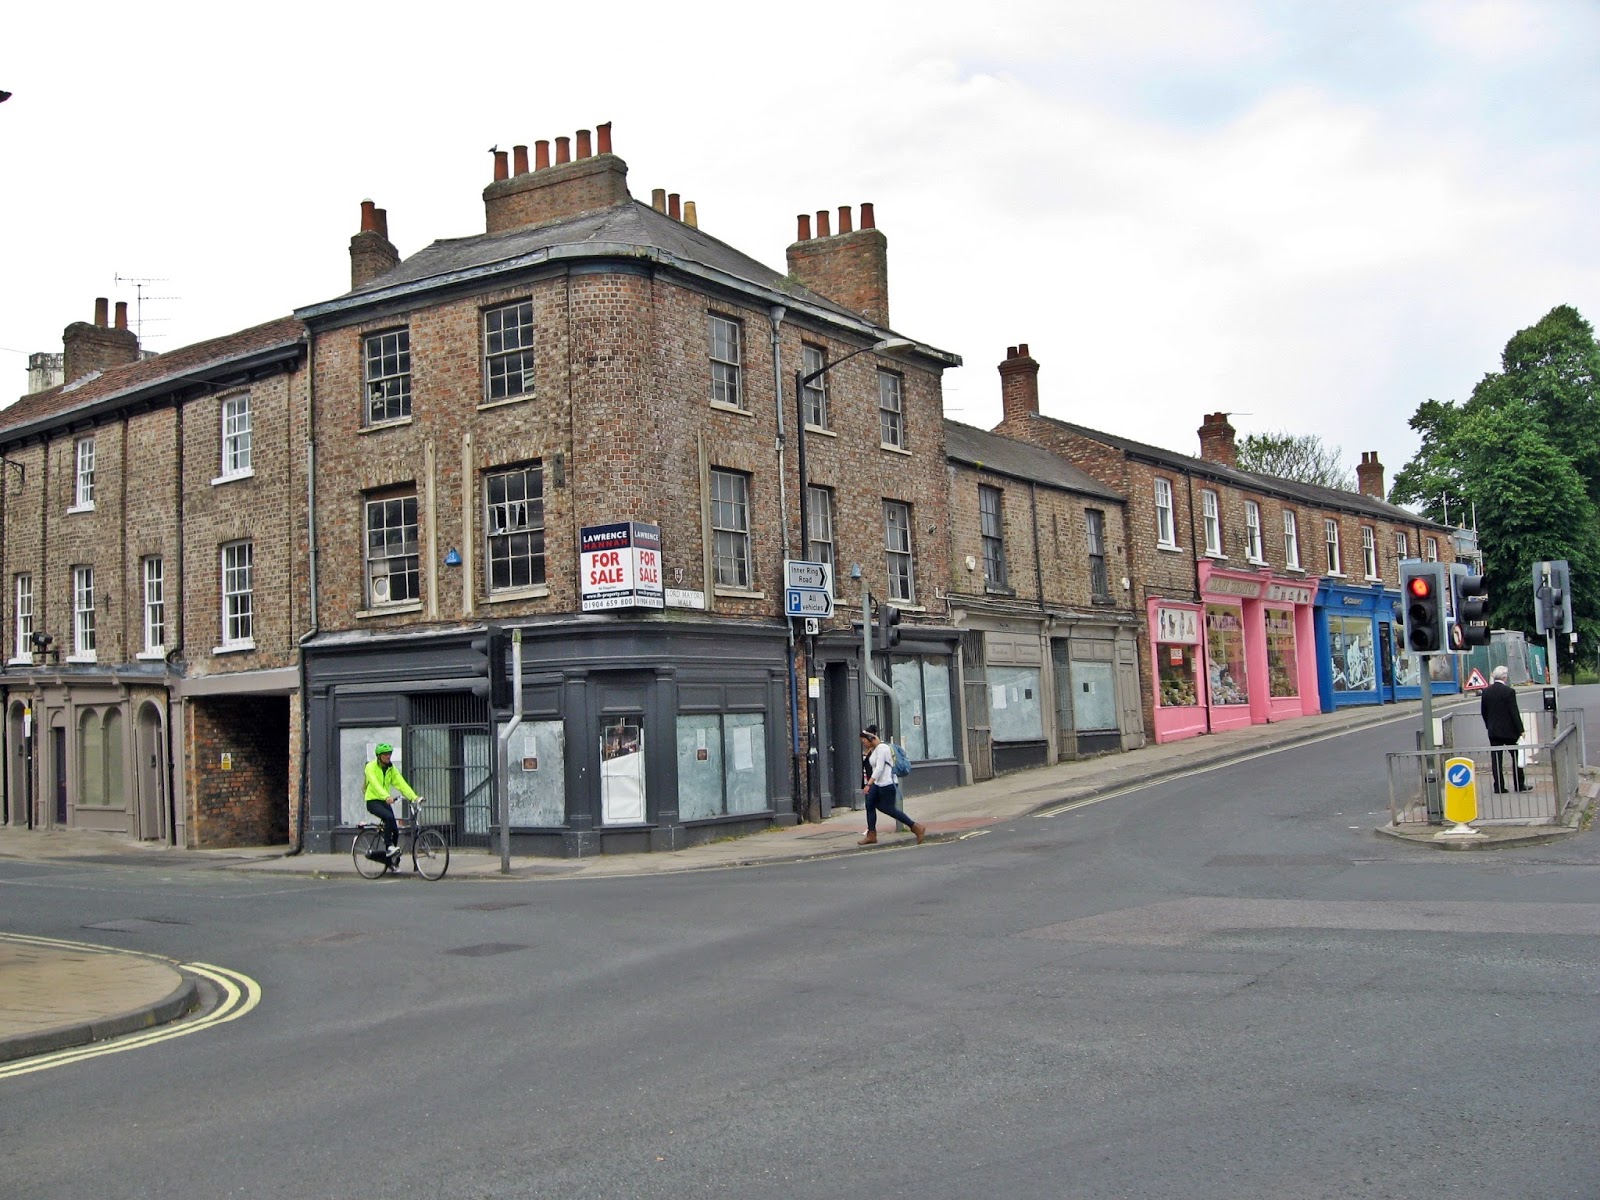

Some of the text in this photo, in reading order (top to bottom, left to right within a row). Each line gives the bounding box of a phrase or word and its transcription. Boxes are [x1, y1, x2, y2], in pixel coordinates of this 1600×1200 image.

[583, 531, 627, 543] LAWRENCE
[634, 531, 659, 541] LAWRENCE
[583, 539, 628, 550] HANNAH
[592, 551, 620, 568] FOR
[640, 551, 656, 566] FOR
[590, 568, 624, 585] SALE
[639, 567, 658, 583] SALE
[807, 567, 818, 576] Ring
[682, 591, 703, 599] MAYORS
[584, 600, 604, 609] 01904
[606, 599, 618, 607] 659
[678, 599, 693, 607] WALK
